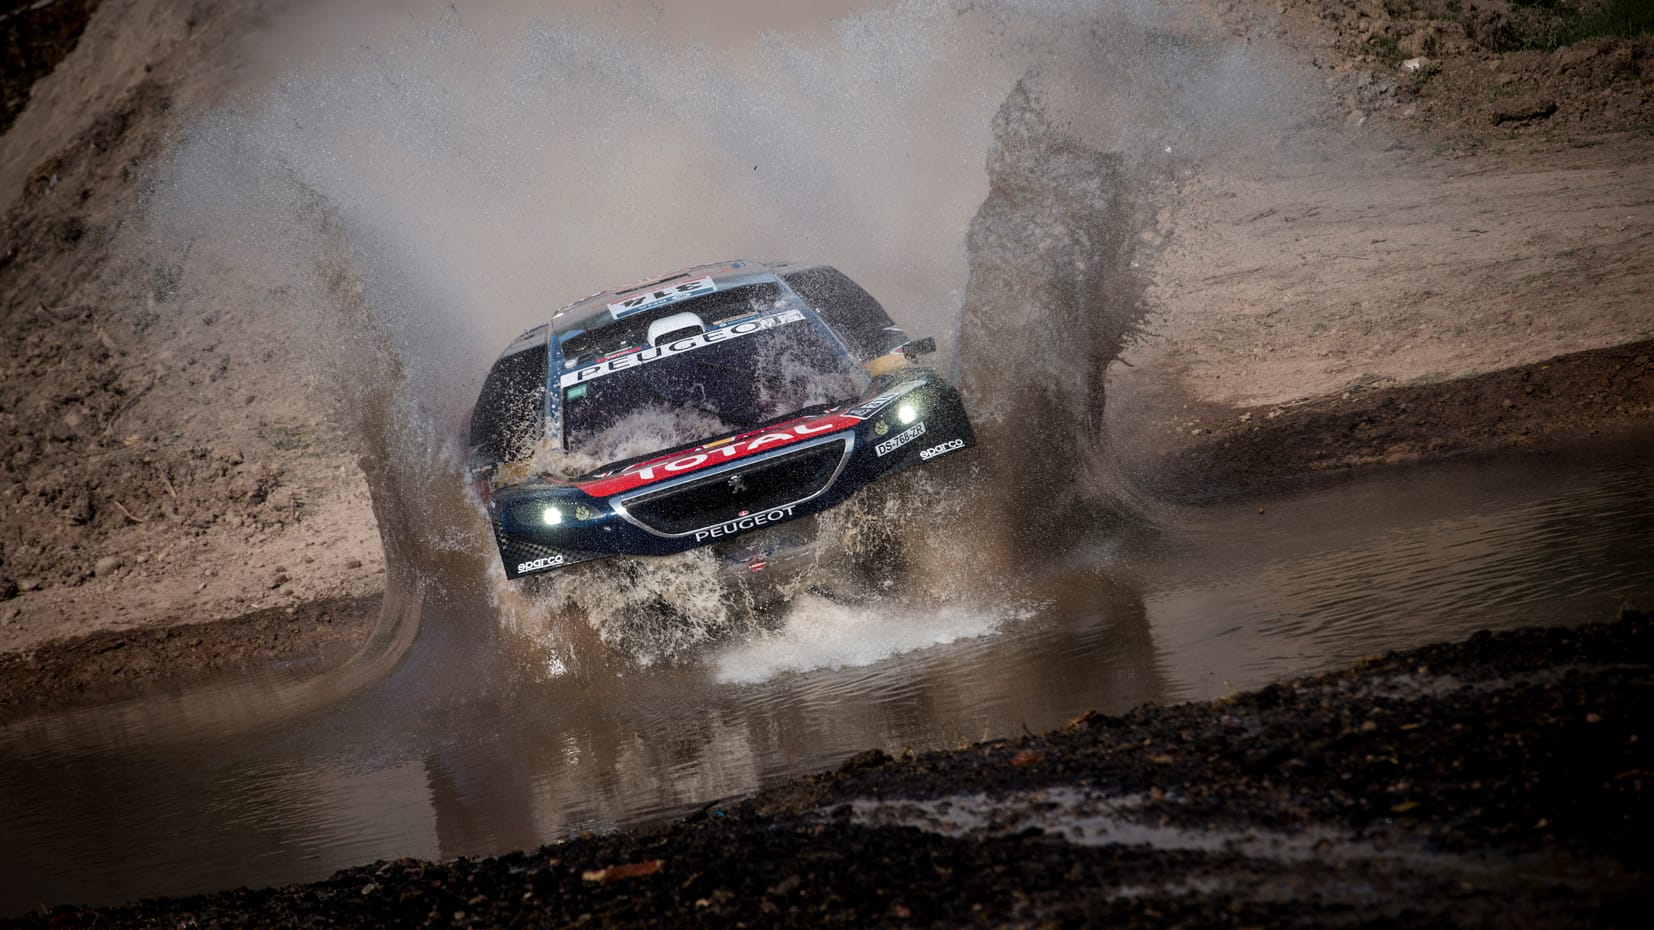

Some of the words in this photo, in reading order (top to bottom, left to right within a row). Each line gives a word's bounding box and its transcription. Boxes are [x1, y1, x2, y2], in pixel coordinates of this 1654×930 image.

[621, 281, 702, 308] 314
[624, 423, 833, 480] TOTAL
[878, 424, 924, 455] DS-768-ZR
[919, 438, 965, 460] sparco
[695, 505, 796, 542] PEUGEOT
[517, 554, 564, 574] sparco
